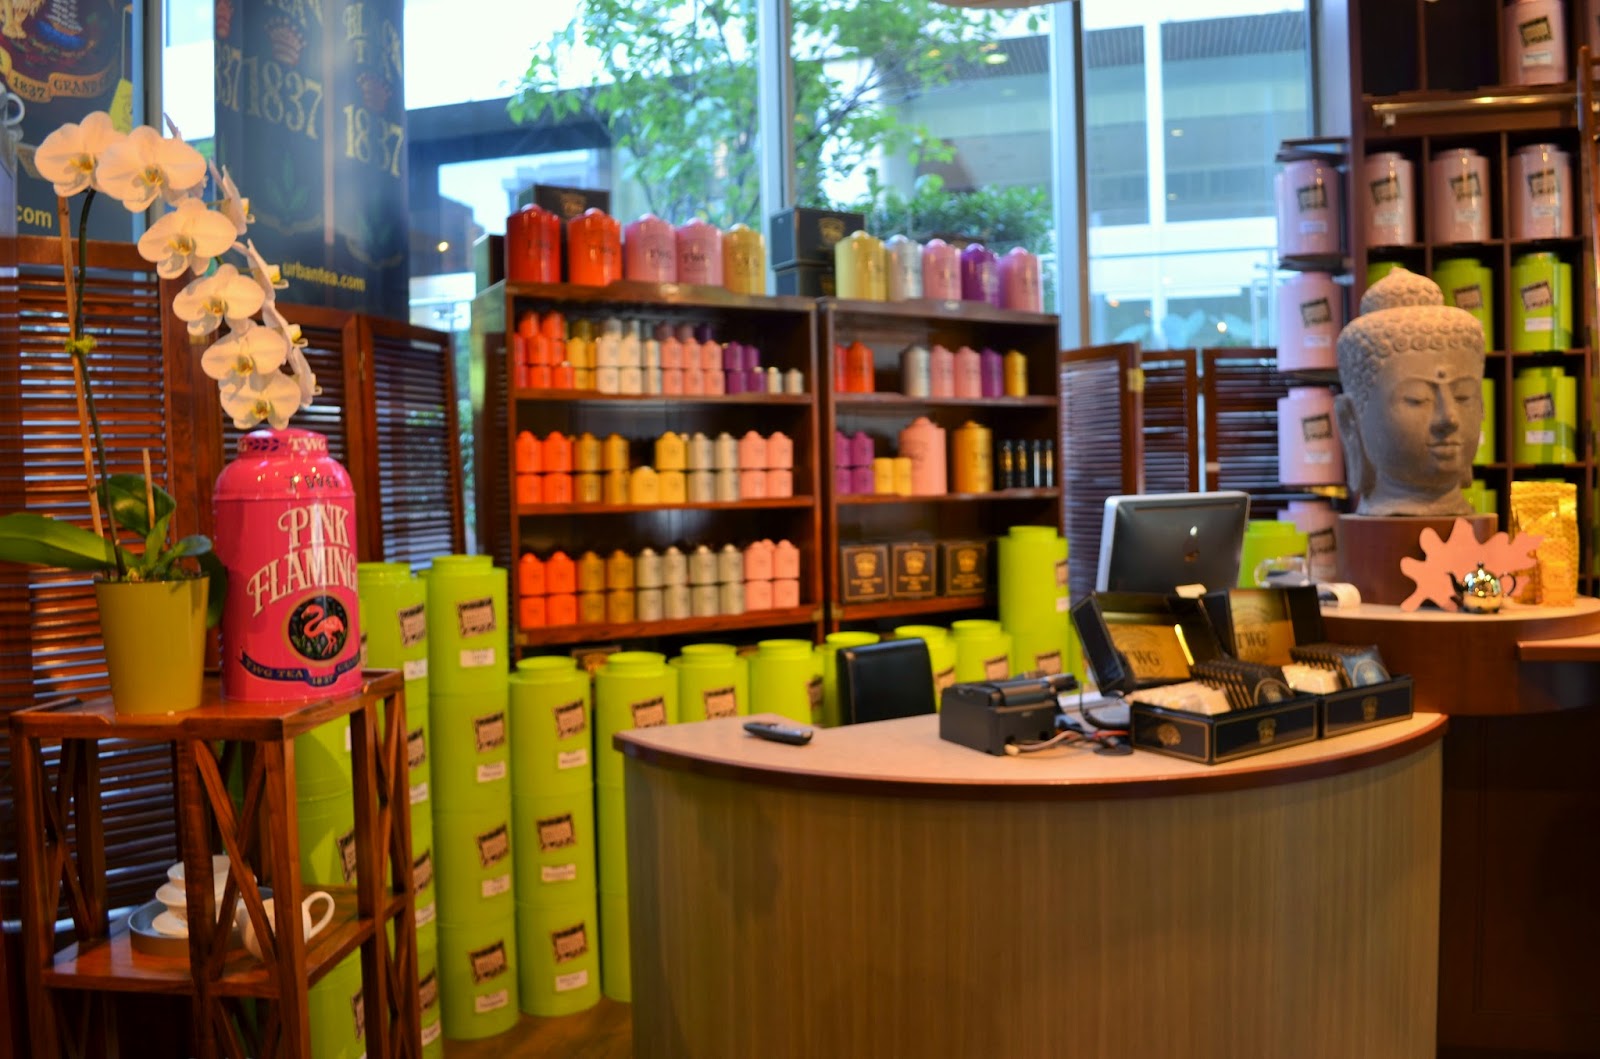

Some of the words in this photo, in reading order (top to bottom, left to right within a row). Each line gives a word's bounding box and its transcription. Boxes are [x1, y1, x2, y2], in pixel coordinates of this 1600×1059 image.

[14, 76, 46, 98] 1837
[243, 56, 324, 140] 1837
[343, 103, 404, 177] 1837
[289, 436, 327, 452] TWG
[278, 503, 350, 550] PINK
[277, 668, 304, 680] TEA
